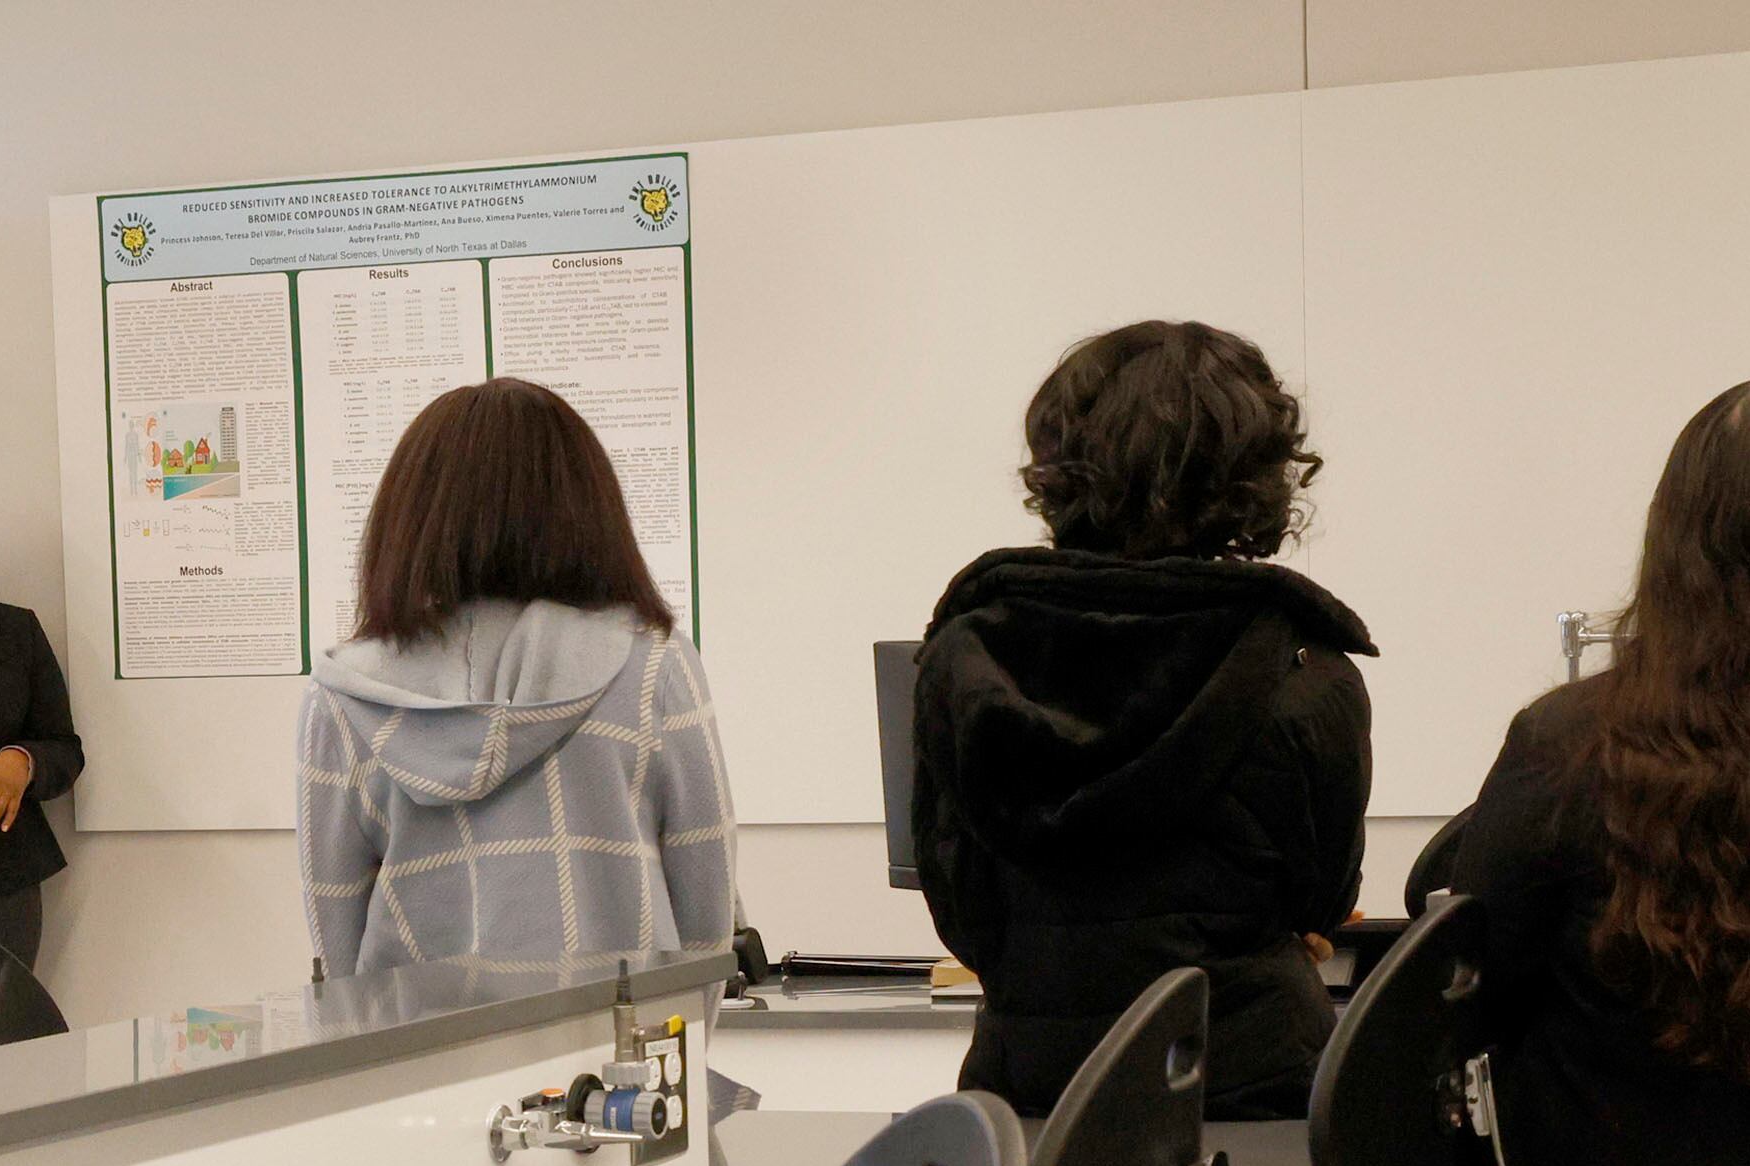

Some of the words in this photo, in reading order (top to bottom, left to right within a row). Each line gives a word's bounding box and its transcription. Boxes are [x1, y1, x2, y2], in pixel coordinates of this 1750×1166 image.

[182, 201, 227, 213] REDUCED
[230, 197, 285, 210] SENSITIVITY
[288, 195, 309, 205] AND
[311, 191, 369, 204] INCREASED
[372, 187, 431, 199] TOLERANCE
[434, 186, 447, 195] TO
[449, 174, 597, 193] ALKYLTRIMETHYLAMMONIUM
[248, 212, 292, 224] BROMIDE
[294, 207, 360, 220] COMPOUNDS
[362, 206, 373, 215] IN
[375, 200, 459, 215] GRAM-NEGATIVE
[461, 195, 524, 208] PATHOGENS
[250, 254, 297, 267] Department
[298, 252, 307, 263] of
[308, 251, 338, 262] Natural
[340, 250, 380, 260] Sciences,
[382, 246, 423, 257] University
[425, 244, 434, 254] of
[436, 243, 459, 253] North
[462, 241, 488, 252] Texas
[490, 240, 498, 250] at
[500, 239, 528, 250] Dallas
[552, 256, 623, 269] Conclusions
[369, 268, 409, 280] Results
[170, 281, 213, 292] Abstract
[180, 565, 223, 576] Methods
